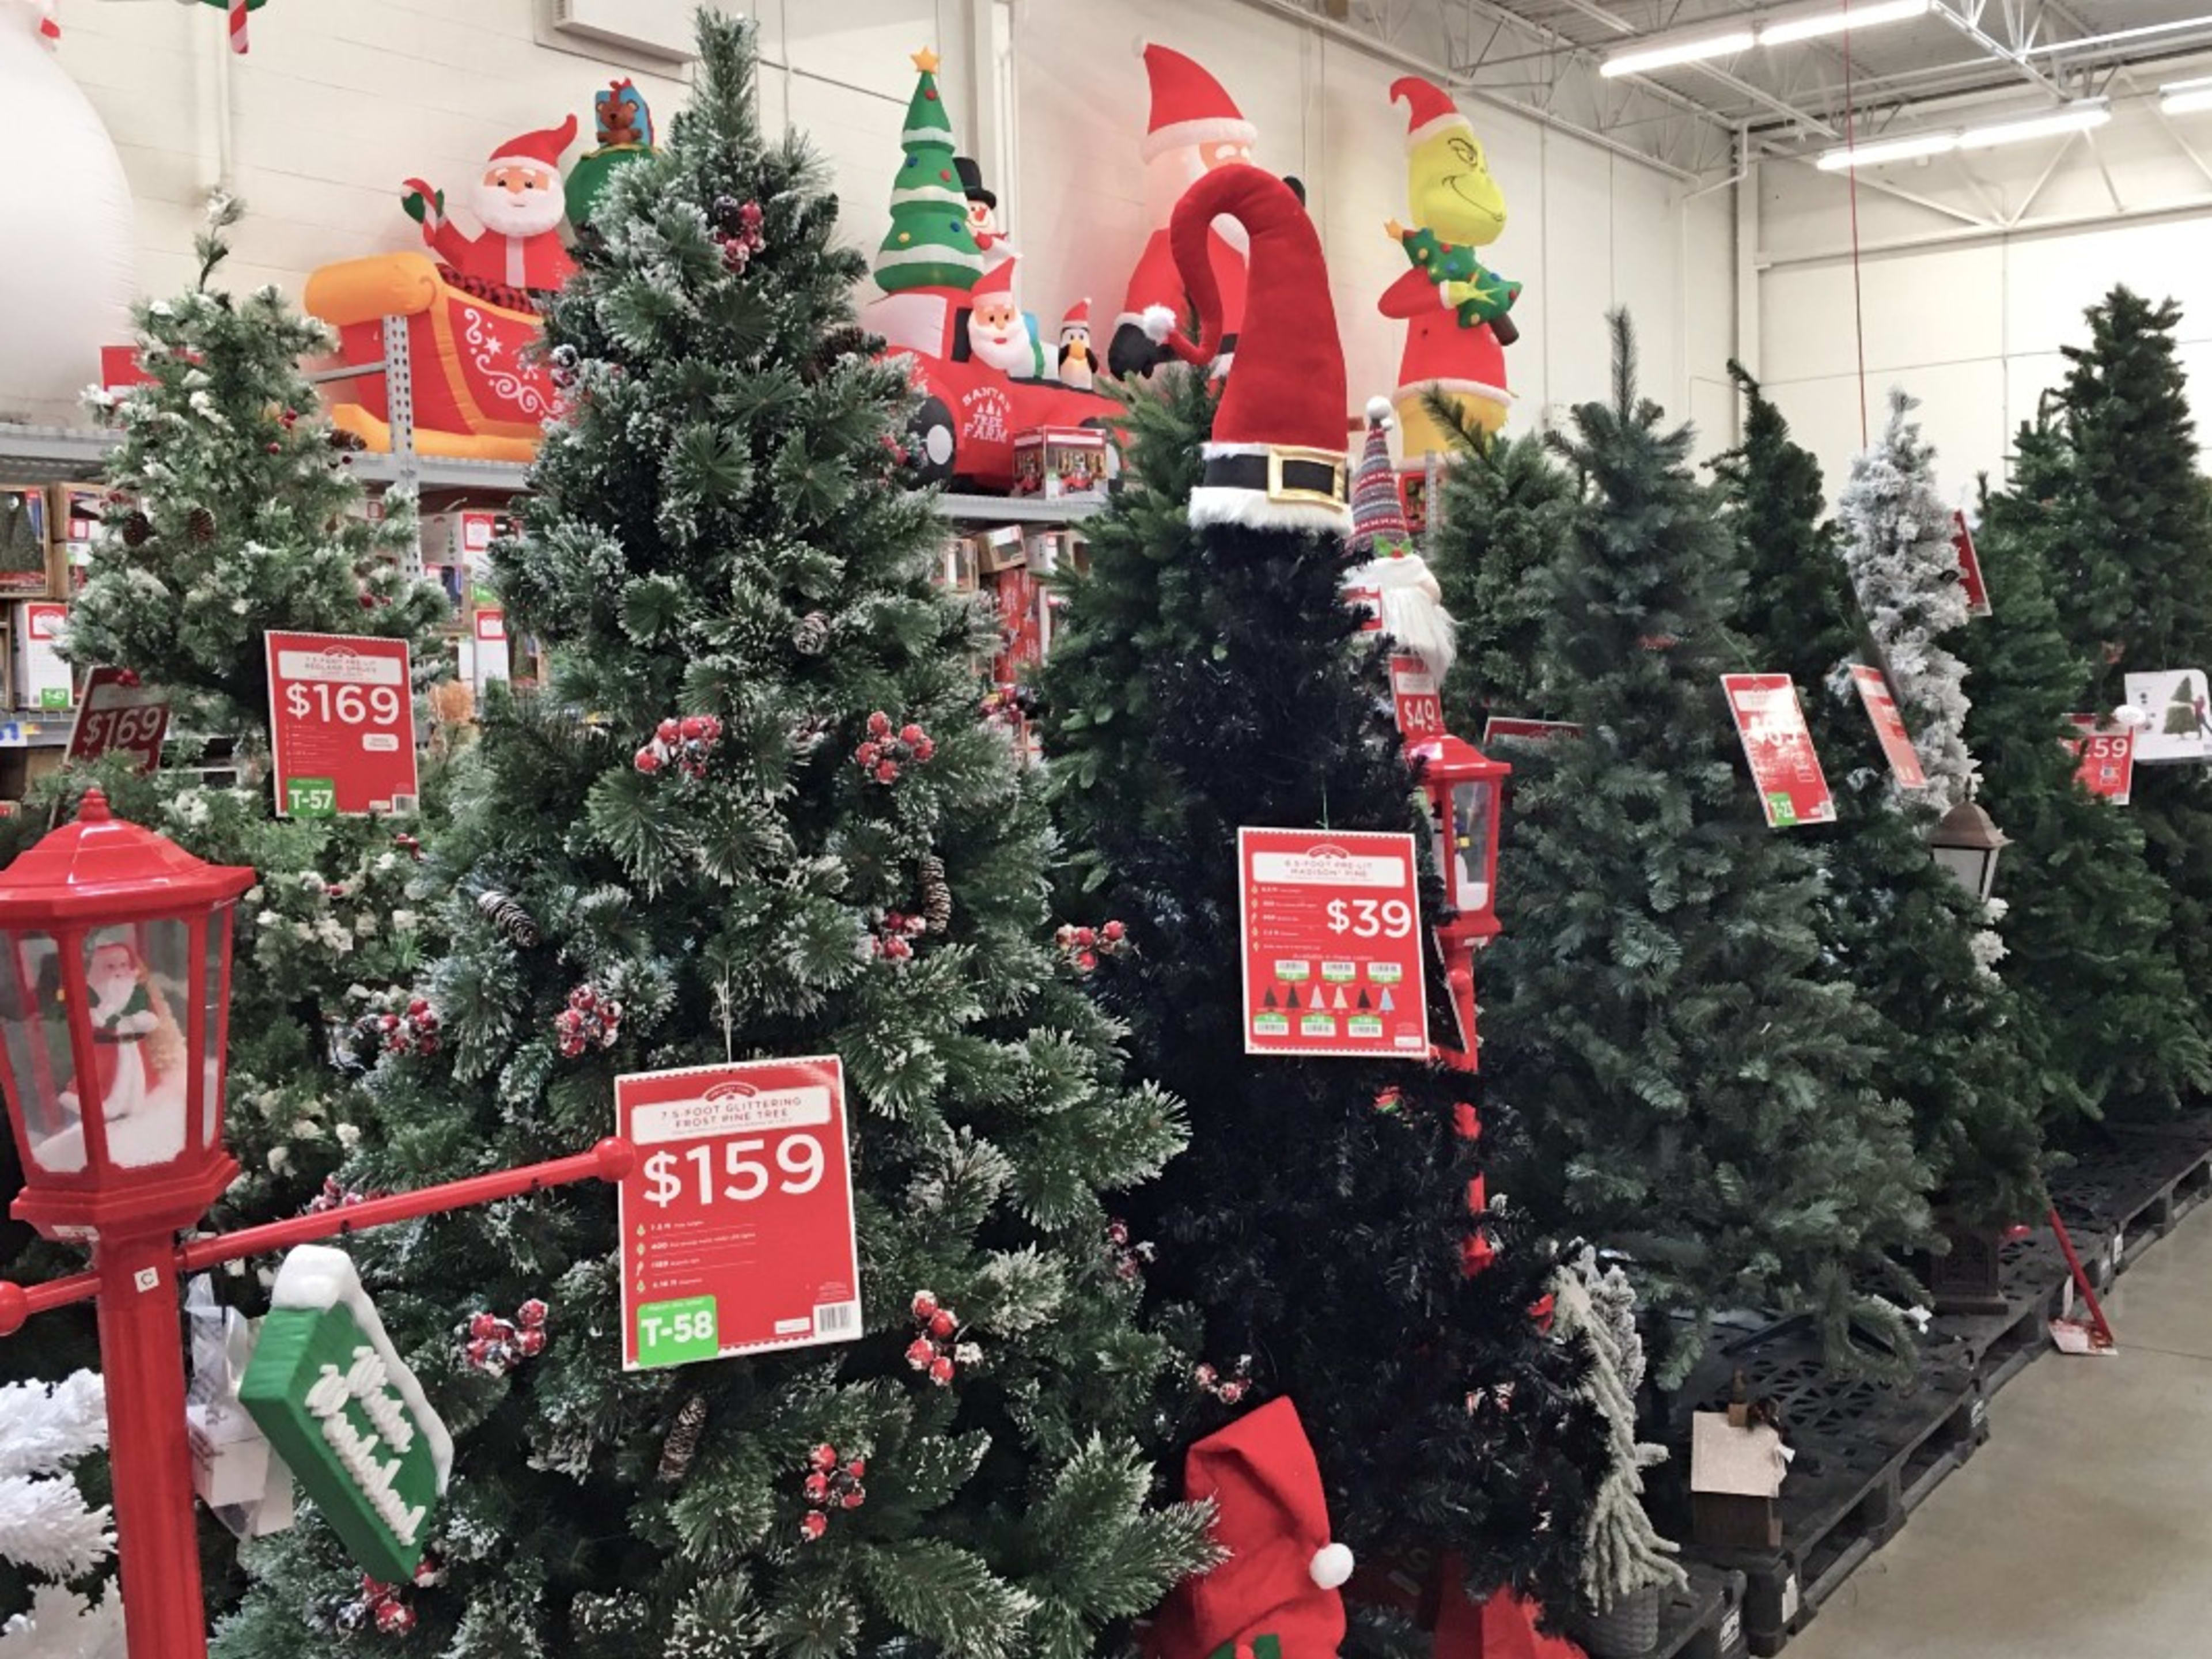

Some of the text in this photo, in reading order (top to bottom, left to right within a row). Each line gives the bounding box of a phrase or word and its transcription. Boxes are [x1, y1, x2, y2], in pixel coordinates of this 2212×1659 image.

[963, 423, 1008, 444] FARM
[972, 414, 1003, 427] TREE
[286, 682, 399, 726] $169
[1404, 698, 1435, 732] $49
[82, 707, 161, 748] $169
[289, 789, 333, 810] T-57
[1327, 897, 1411, 938] $39
[726, 1096, 802, 1112] GLITTERING
[676, 1116, 717, 1128] FROST
[721, 1112, 751, 1123] PINE
[757, 1108, 788, 1119] TREE
[643, 1134, 824, 1208] $159
[141, 1272, 154, 1286] C
[641, 1310, 714, 1347] T-58
